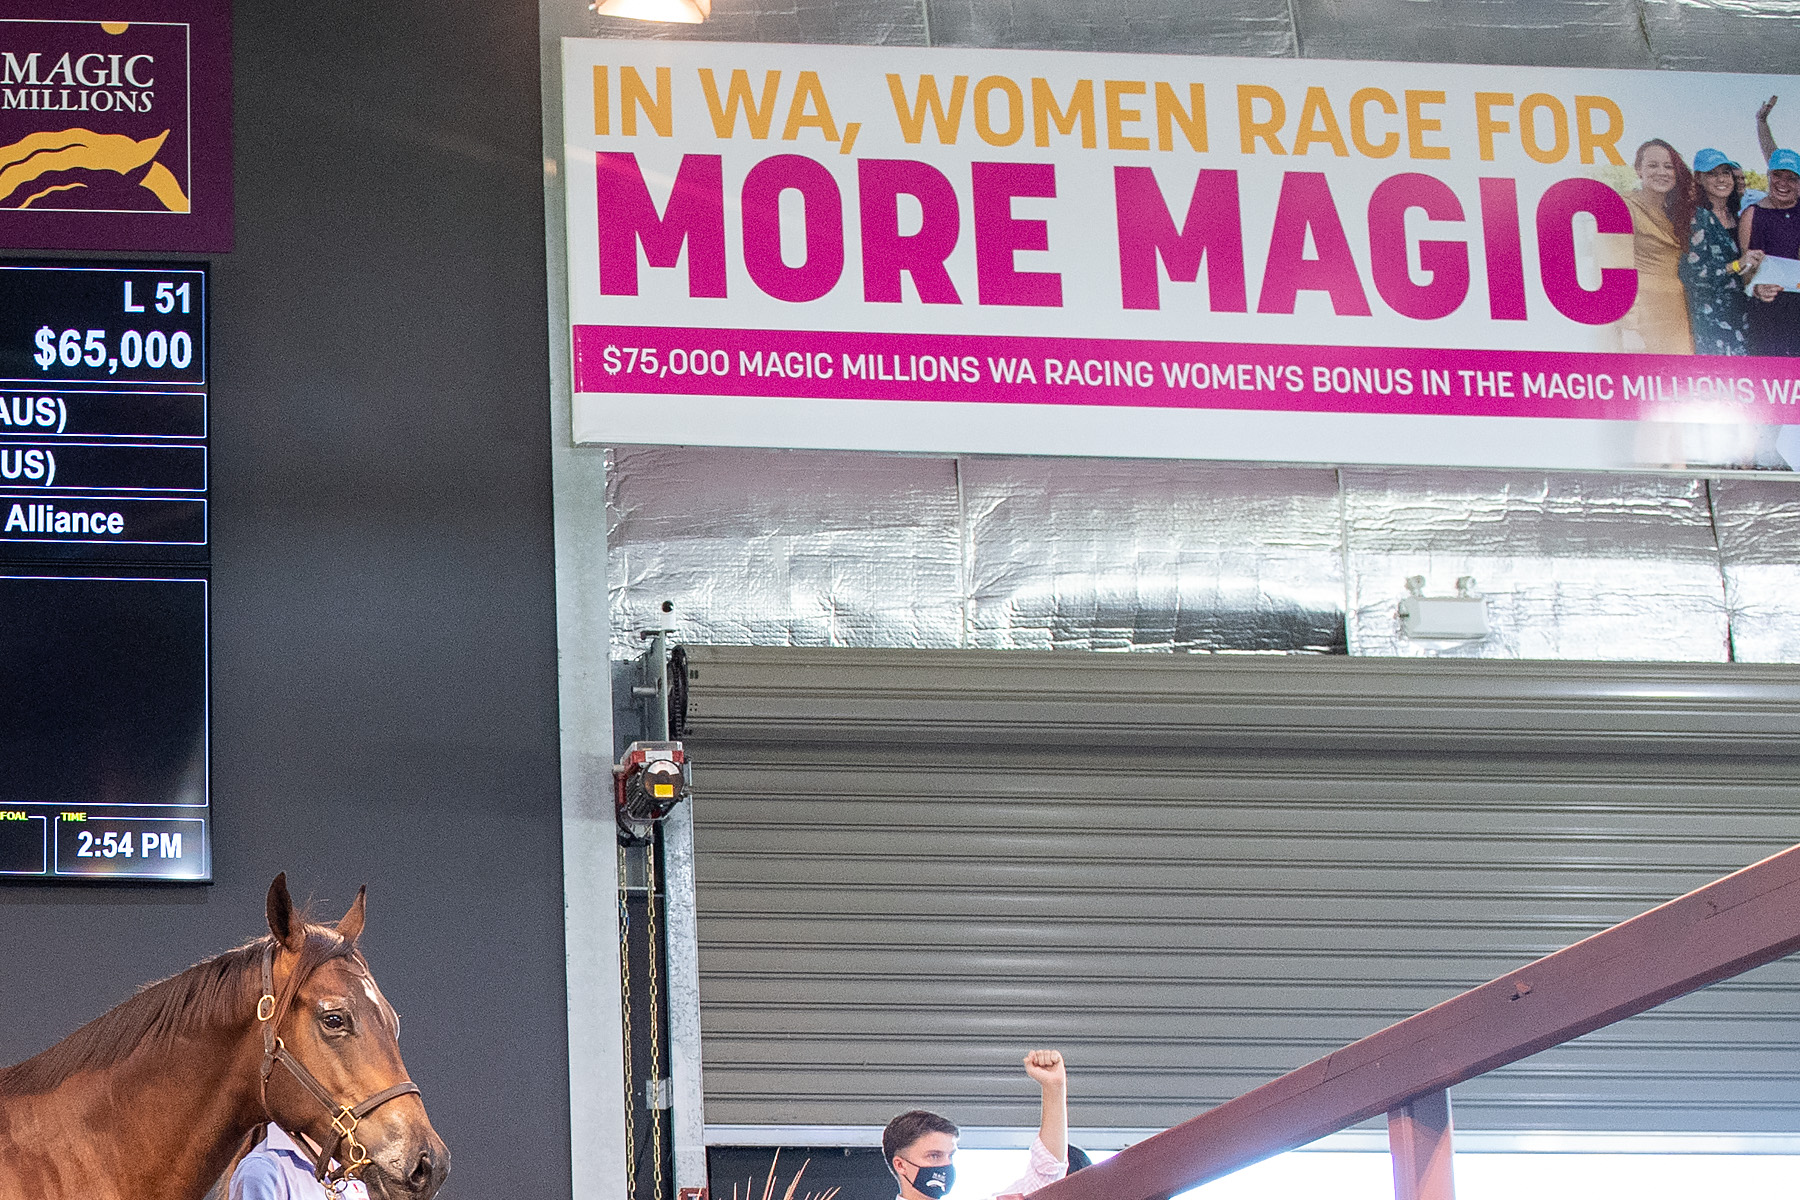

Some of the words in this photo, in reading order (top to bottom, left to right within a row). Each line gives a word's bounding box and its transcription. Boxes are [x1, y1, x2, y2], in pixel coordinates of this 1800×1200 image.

[0, 52, 153, 87] MAGIC
[2, 89, 154, 112] MILLIONS
[593, 65, 672, 137] IN
[698, 68, 861, 154] WA,
[886, 74, 1208, 152] WOMEN
[1237, 85, 1450, 159] RACE
[1475, 92, 1626, 166] FOR
[596, 149, 1063, 307] MORE
[1113, 165, 1640, 326] MAGIC
[124, 281, 145, 312] L
[155, 282, 190, 314] 51
[33, 325, 192, 375] $65,000
[603, 345, 729, 378] $75,000
[740, 351, 833, 378] MAGIC
[843, 354, 980, 382] MILLIONS
[988, 358, 1037, 384] WA
[1045, 359, 1153, 387] RACING
[1313, 367, 1413, 395] BONUS
[1422, 370, 1450, 395] IN
[1458, 371, 1514, 397] THE
[1523, 373, 1614, 400] MAGIC
[1622, 375, 1756, 404] MILLIONS
[4, 504, 124, 534] Alliance
[0, 810, 27, 821] FOAL
[61, 811, 87, 821] TIME
[77, 830, 134, 858] 2:54
[141, 833, 184, 861] PM
